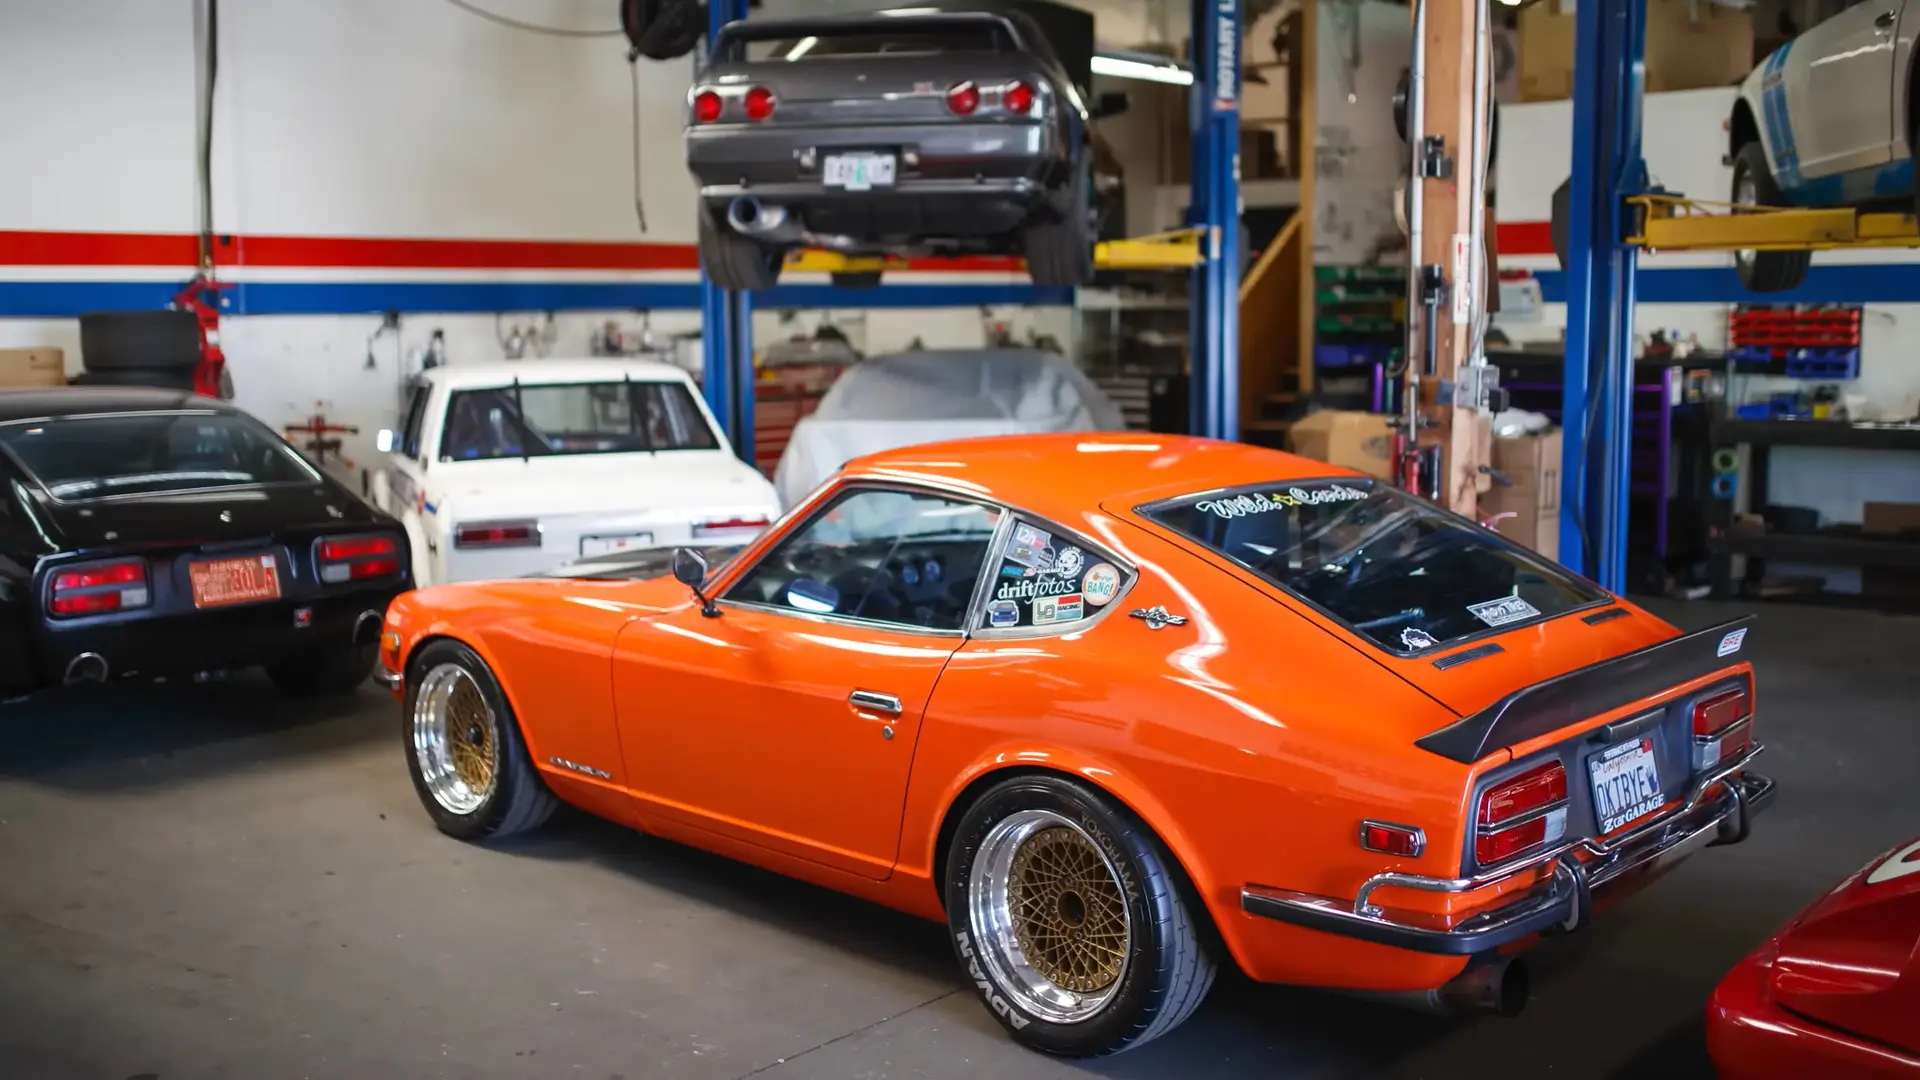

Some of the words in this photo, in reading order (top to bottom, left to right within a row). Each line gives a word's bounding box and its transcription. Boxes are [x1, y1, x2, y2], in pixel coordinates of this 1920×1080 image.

[997, 574, 1076, 604] driftfotos
[1087, 581, 1113, 596] BANG!
[1081, 814, 1139, 903] YOKOHAMA
[956, 931, 1031, 1030] ADVAN
